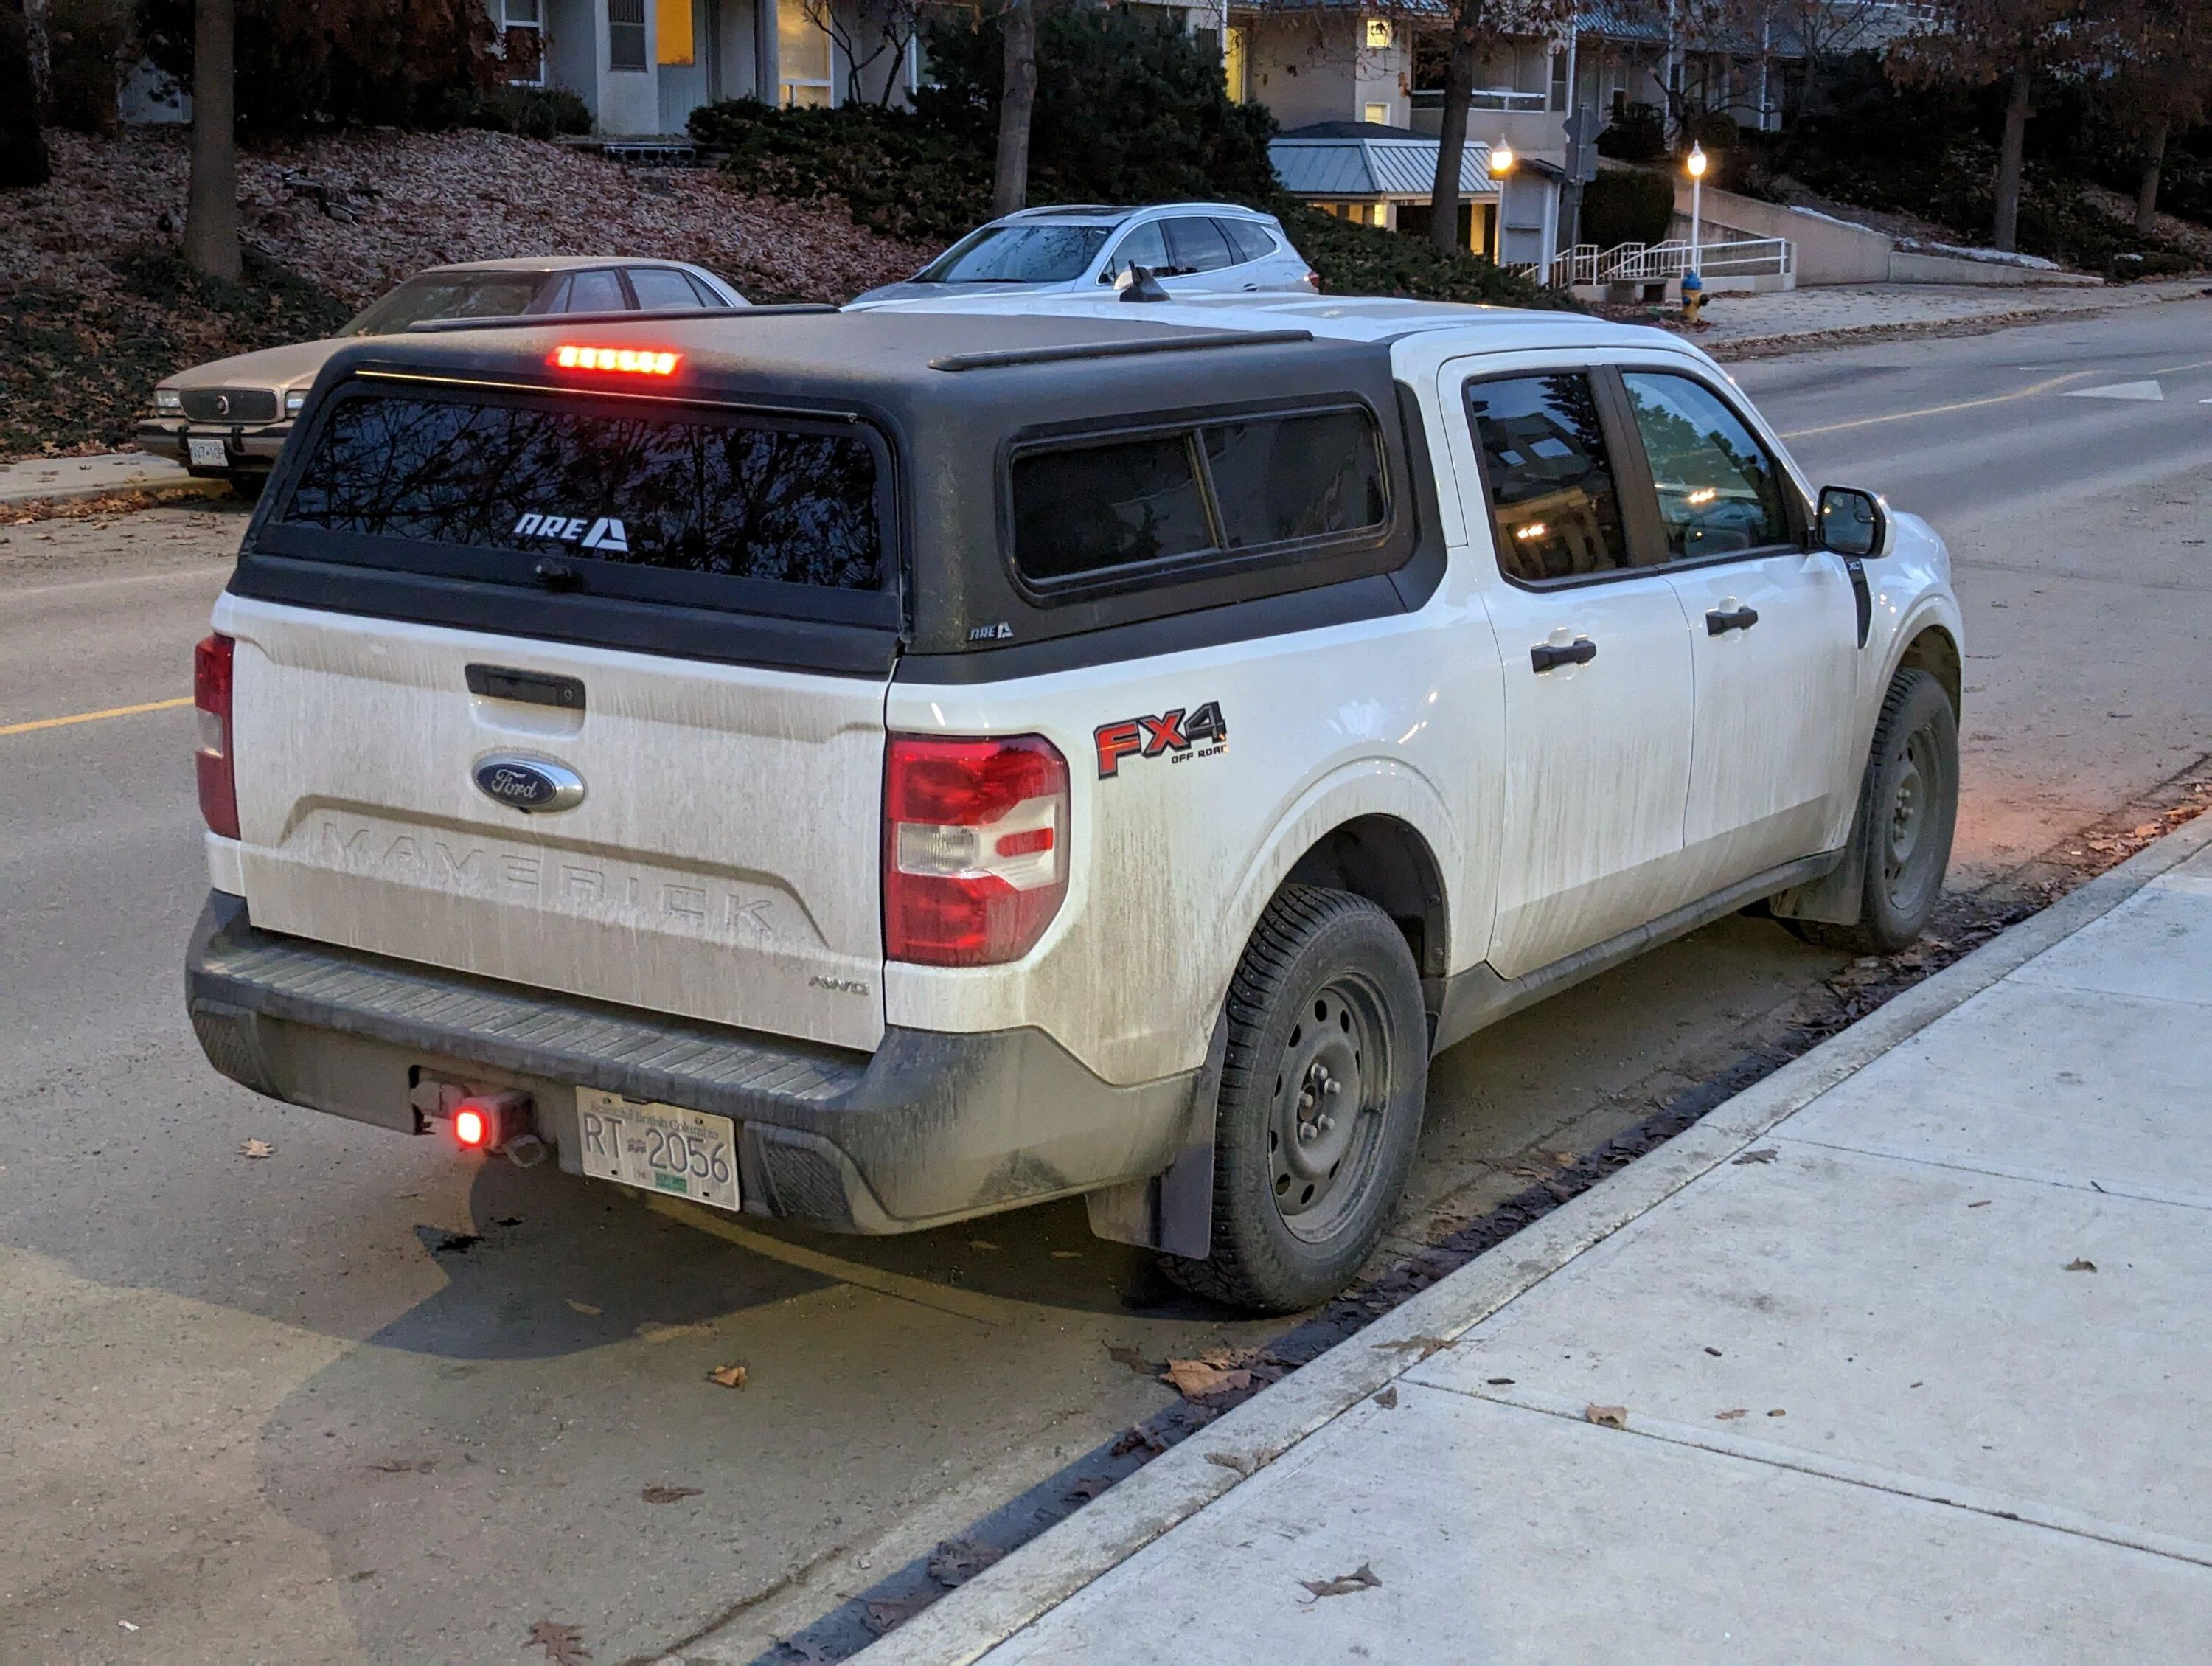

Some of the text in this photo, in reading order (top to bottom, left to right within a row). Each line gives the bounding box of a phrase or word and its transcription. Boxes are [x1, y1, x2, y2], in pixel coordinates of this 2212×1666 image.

[1093, 701, 1227, 780] FX4
[1172, 752, 1193, 763] OFF
[491, 768, 538, 799] Ford
[321, 822, 773, 934] MAVERICK
[584, 1112, 729, 1184] RT 2056
